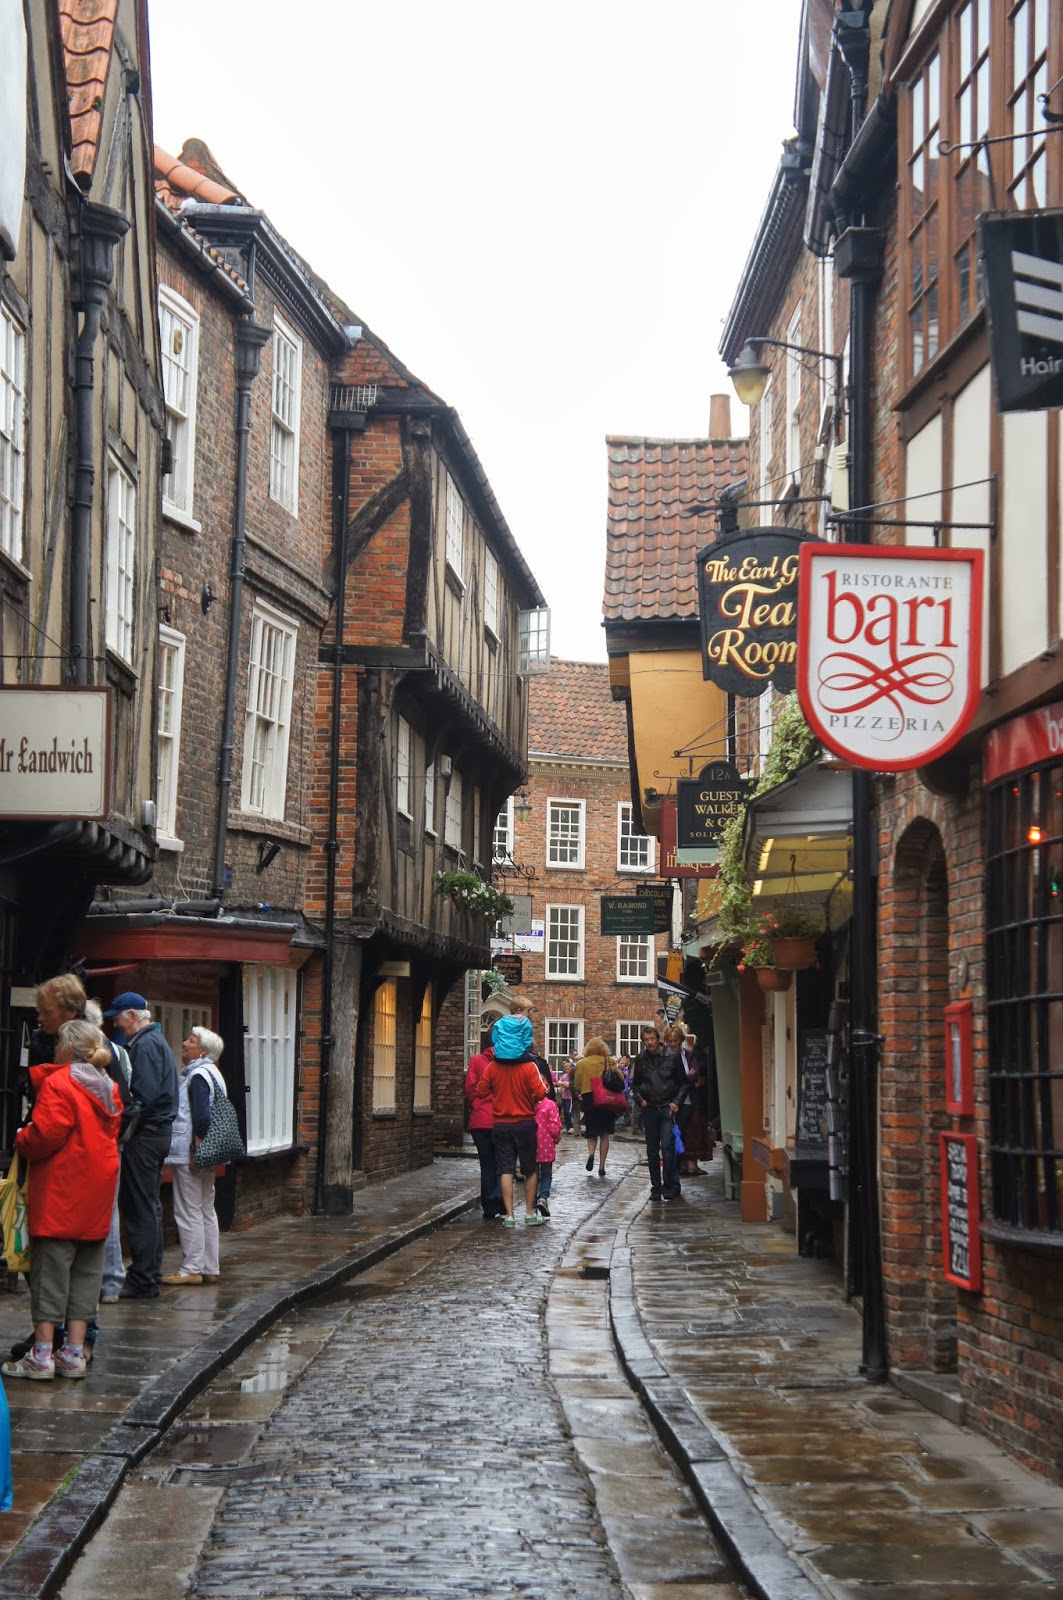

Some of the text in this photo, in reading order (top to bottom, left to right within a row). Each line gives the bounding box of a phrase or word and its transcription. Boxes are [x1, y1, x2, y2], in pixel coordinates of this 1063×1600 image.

[1020, 355, 1063, 376] Hair
[706, 555, 737, 582] The
[738, 556, 779, 580] Earl
[841, 572, 954, 590] RISTORANTE
[721, 582, 797, 629] Tea
[821, 569, 959, 648] bari
[829, 714, 946, 733] PIZZERIA
[711, 768, 731, 780] 12A
[700, 791, 741, 801] GUEST
[705, 818, 715, 828] &
